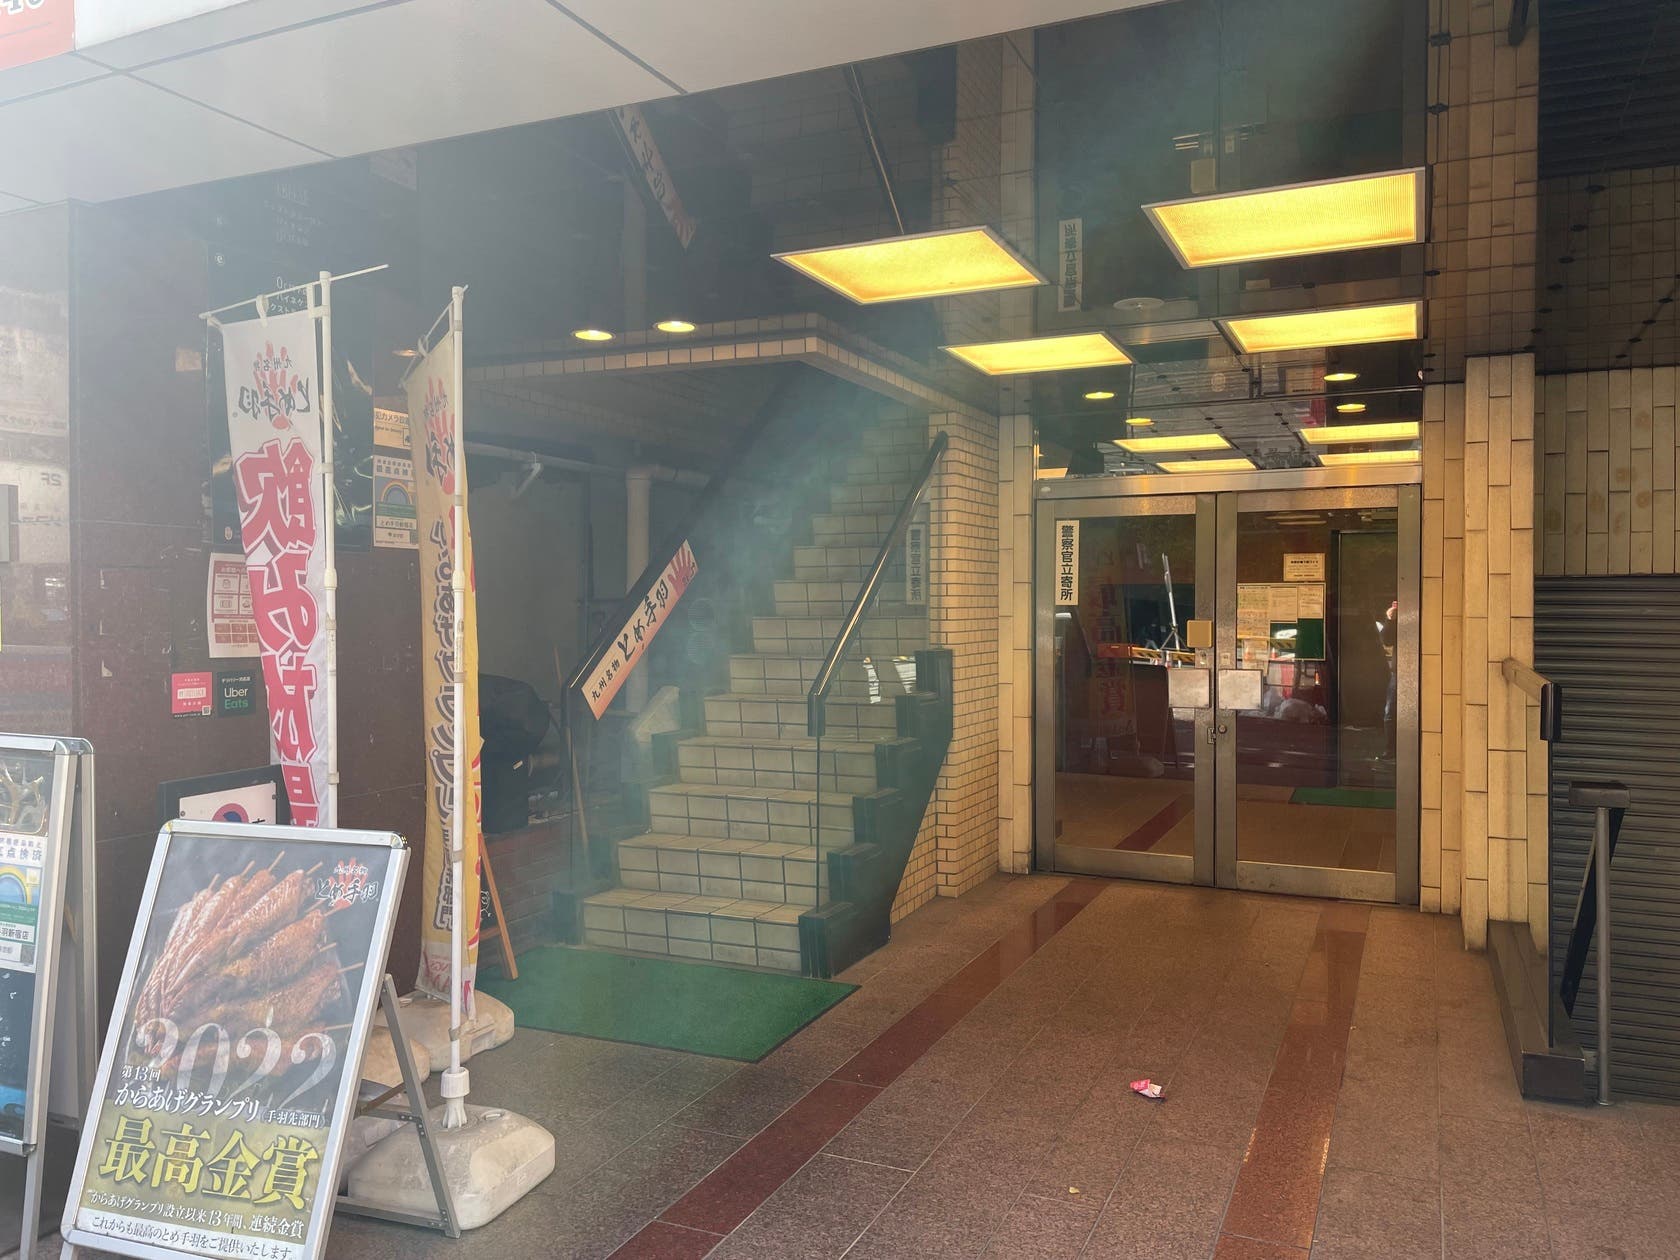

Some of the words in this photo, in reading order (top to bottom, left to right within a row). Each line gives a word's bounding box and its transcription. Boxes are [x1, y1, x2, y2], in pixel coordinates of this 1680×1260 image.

[1060, 525, 1074, 602] 警察官立寄所
[591, 657, 620, 702] 九州名物
[617, 578, 669, 663] とめ手羽
[224, 687, 250, 698] Uber
[224, 698, 250, 709] Eats
[314, 877, 380, 908] とめ手羽
[121, 1064, 161, 1082] 第13回
[137, 1017, 337, 1112] 2022
[114, 1083, 260, 1122] からあげグランプリ
[98, 1115, 319, 1211] 最高金賞
